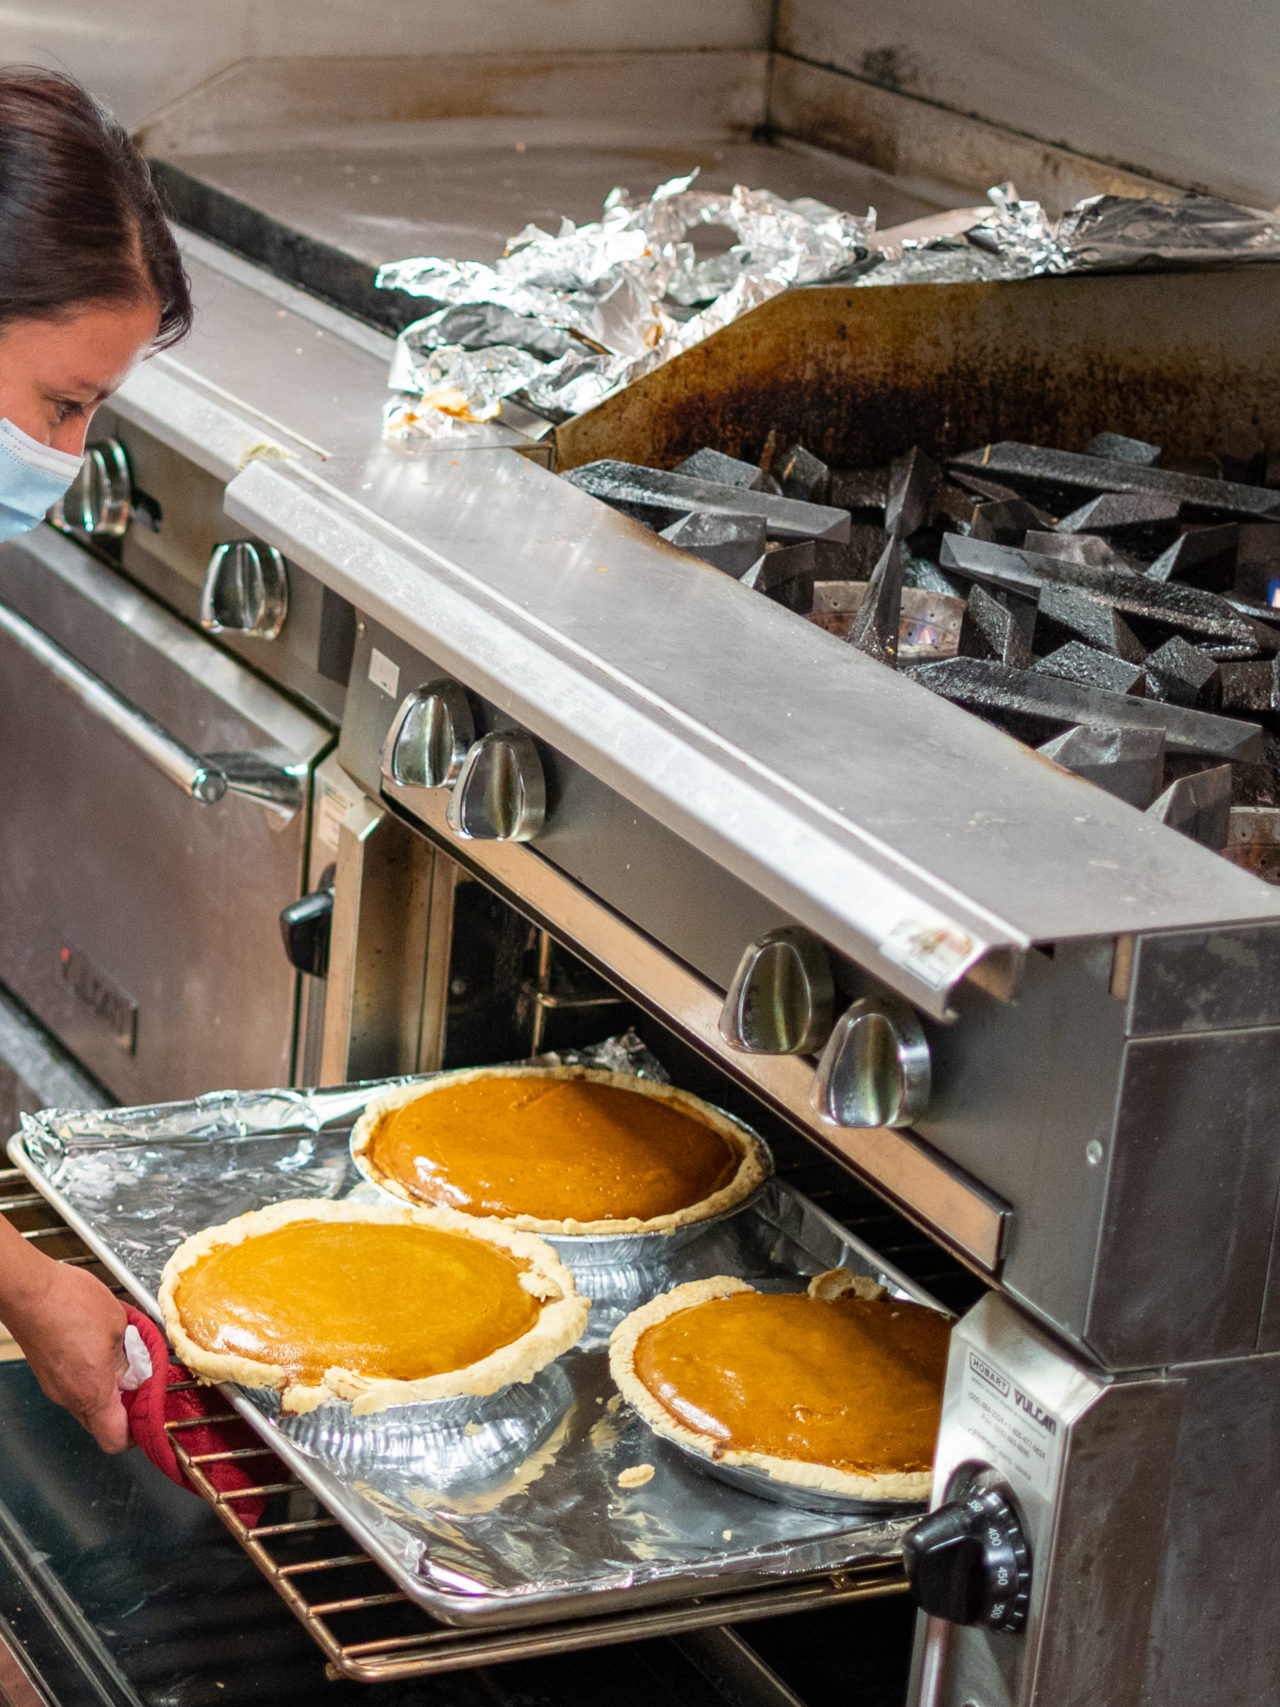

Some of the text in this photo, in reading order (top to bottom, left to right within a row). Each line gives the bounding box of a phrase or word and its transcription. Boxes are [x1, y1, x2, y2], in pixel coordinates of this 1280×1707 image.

[972, 1358, 1007, 1390] HOBART
[1014, 1387, 1057, 1437] VULCAN
[987, 1527, 1002, 1547] 400
[997, 1566, 1009, 1586] 450
[990, 1603, 1005, 1619] 500
